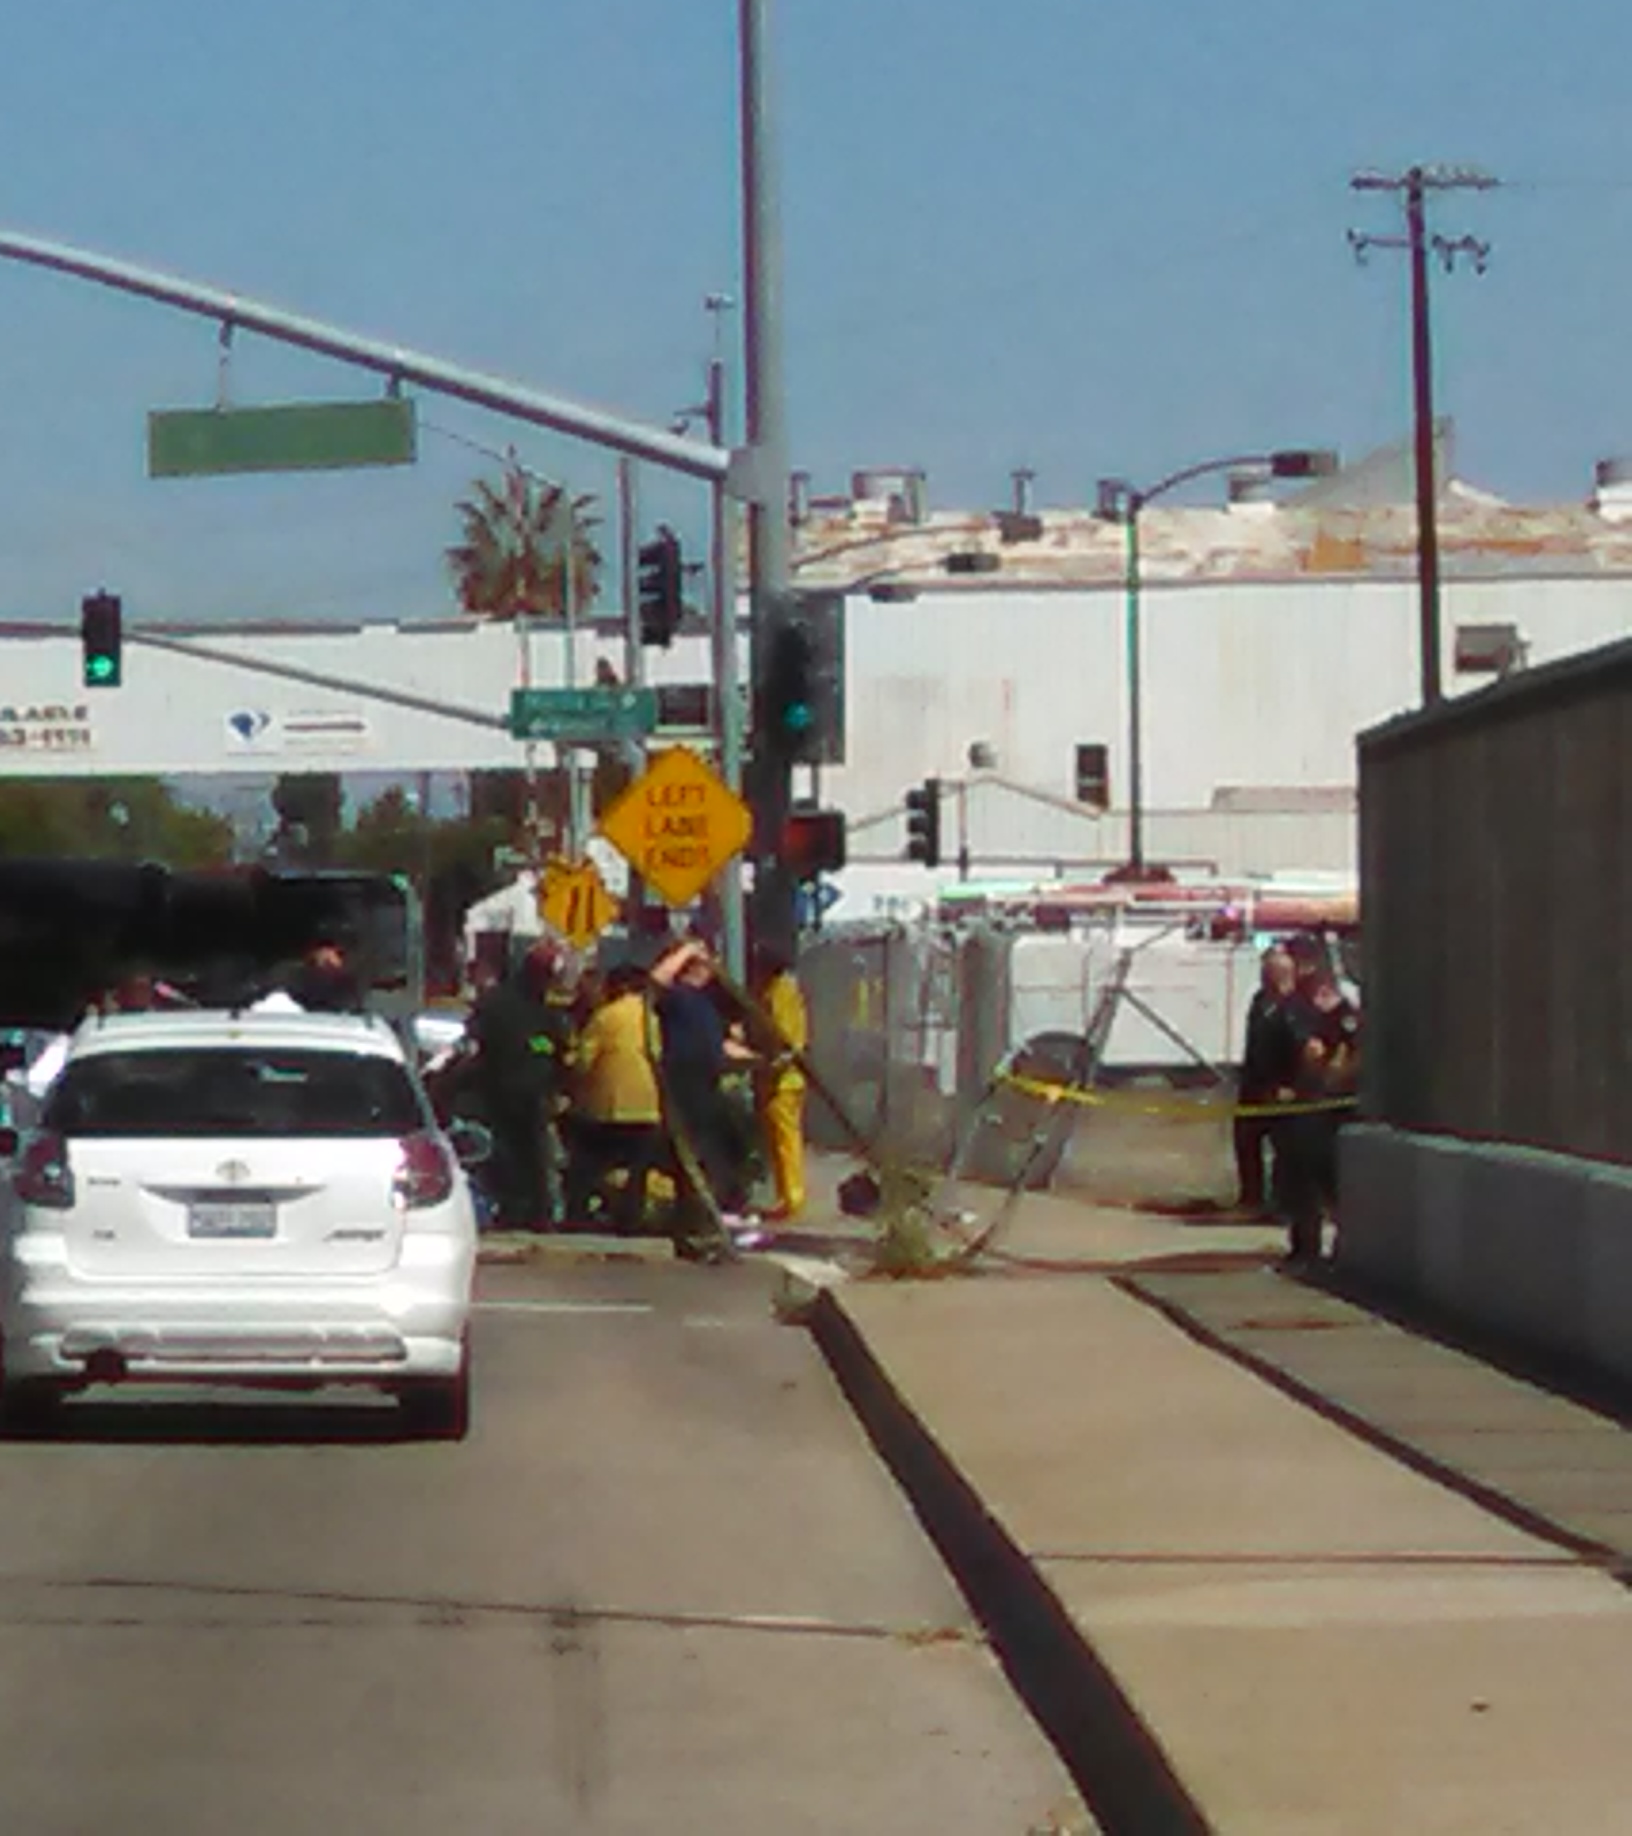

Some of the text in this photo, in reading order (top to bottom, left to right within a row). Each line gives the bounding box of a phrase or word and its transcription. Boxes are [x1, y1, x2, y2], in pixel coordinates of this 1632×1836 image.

[645, 785, 706, 807] LEFT
[644, 814, 709, 839] LANE
[644, 844, 711, 868] ENDS
